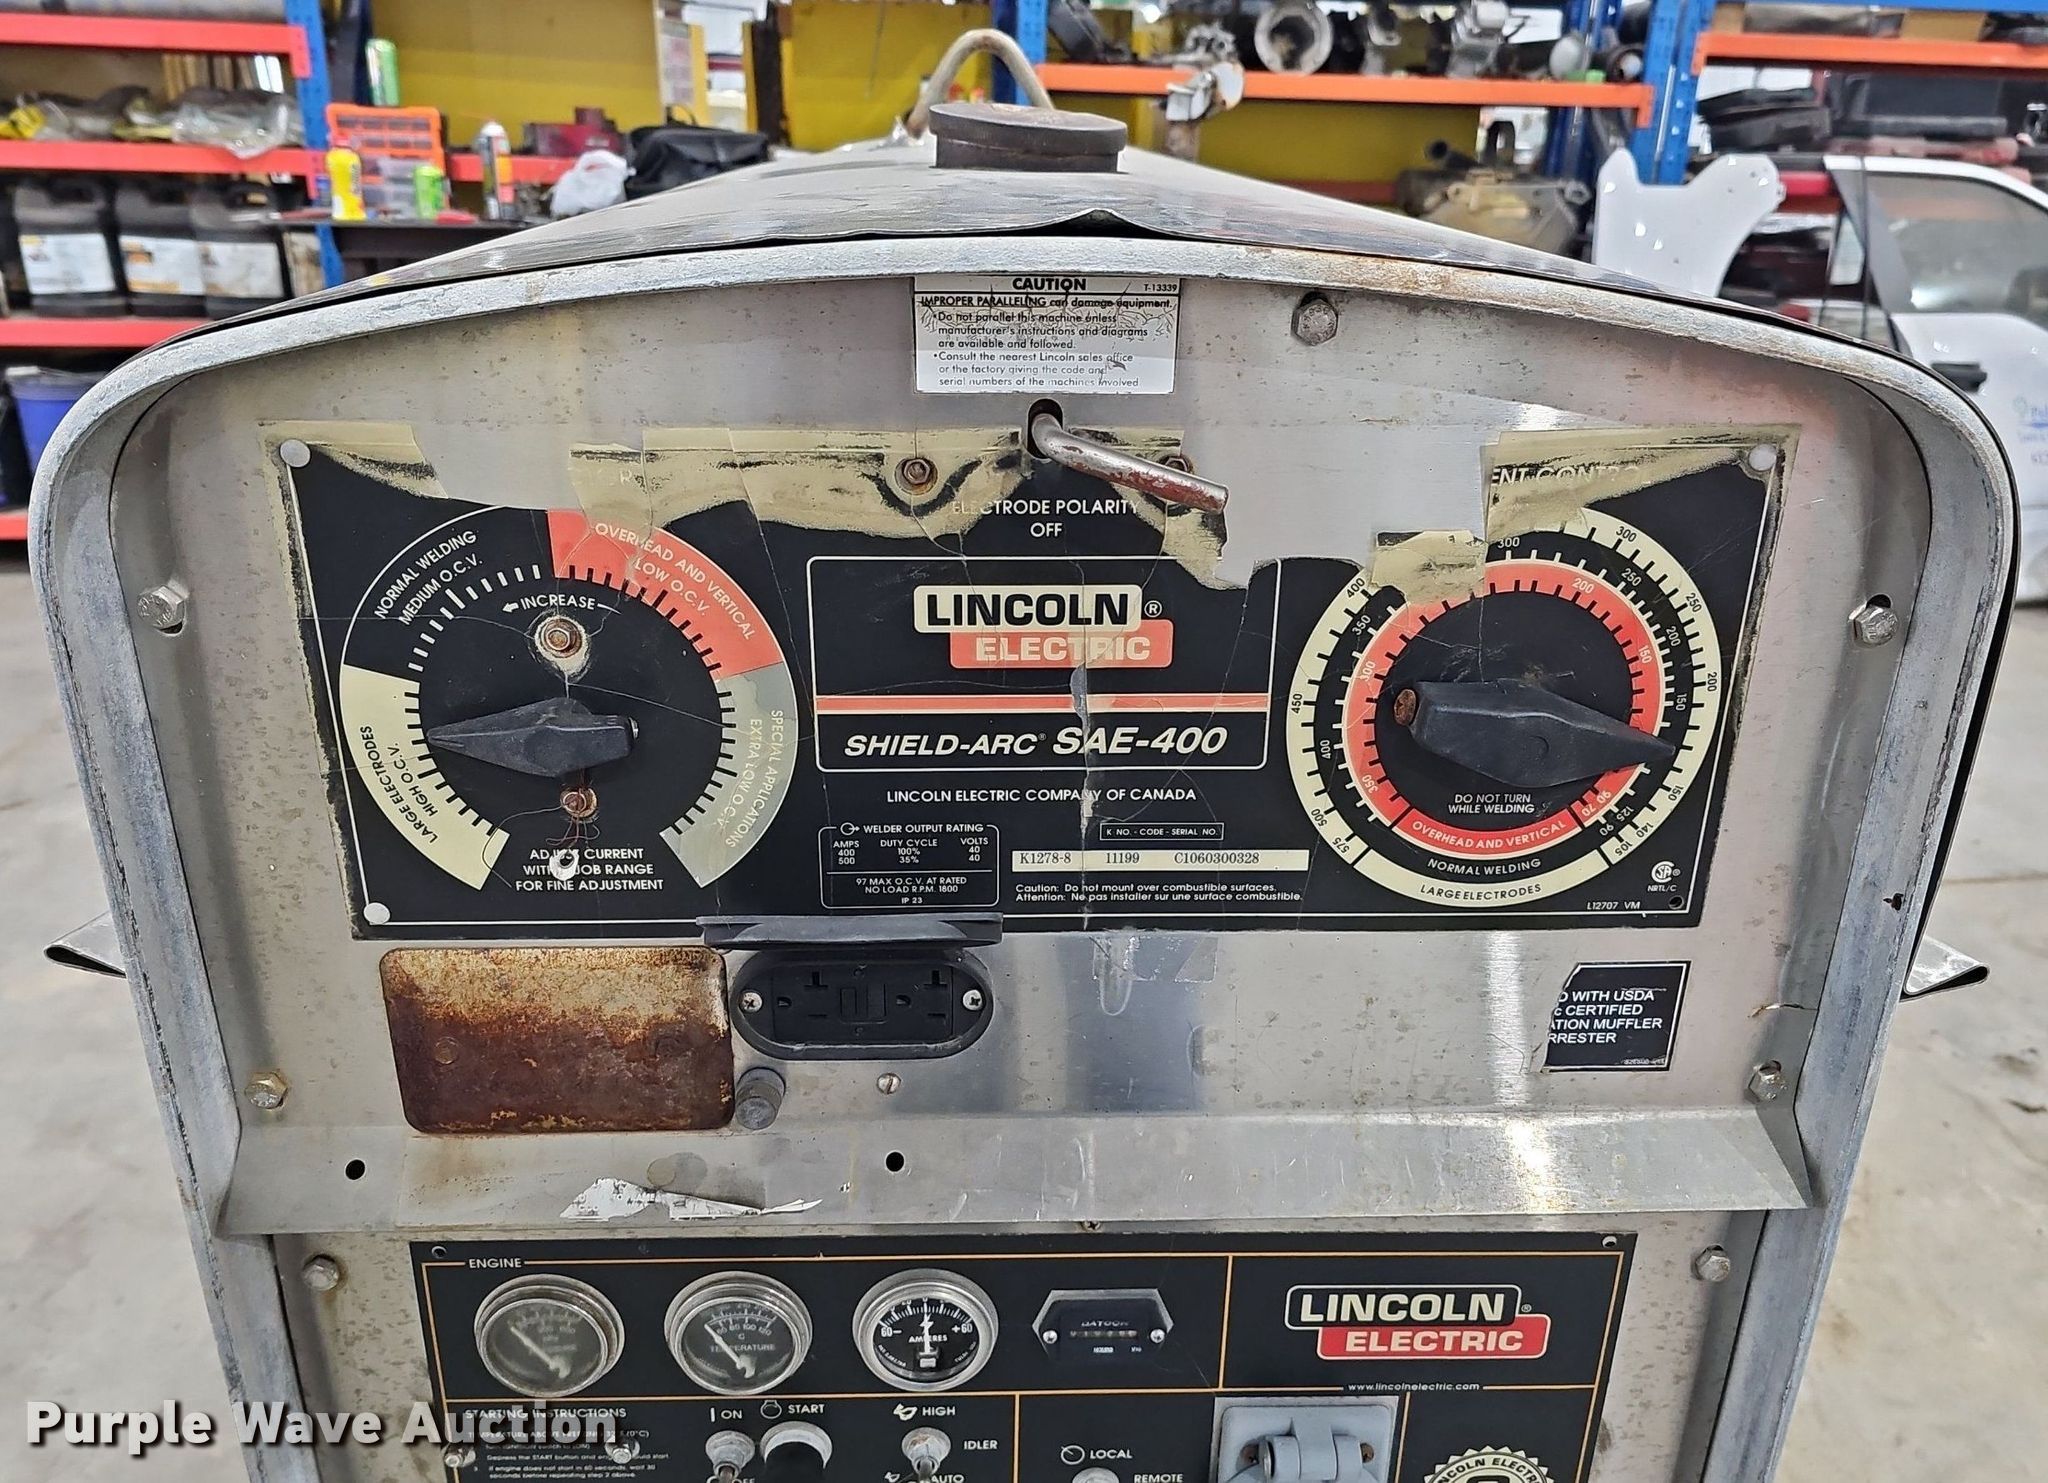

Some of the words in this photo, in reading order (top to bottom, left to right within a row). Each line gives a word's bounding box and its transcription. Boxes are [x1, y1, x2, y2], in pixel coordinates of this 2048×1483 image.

[1012, 277, 1086, 291] CAUTION
[1144, 283, 1177, 292] T-13339
[921, 296, 974, 306] IMPROPER
[977, 296, 1046, 307] PARALLELING
[1050, 299, 1068, 307] can
[1117, 298, 1172, 309] equipment.
[938, 311, 952, 321] Do
[956, 312, 972, 321] not
[976, 311, 1014, 323] parallel
[1018, 312, 1035, 321] this
[1039, 312, 1081, 322] machine
[1085, 312, 1117, 322] unless
[938, 325, 1015, 335] manufacturer's
[1018, 326, 1075, 336] instructions
[1079, 326, 1098, 336] and
[1101, 326, 1148, 338] diagrams
[938, 340, 955, 348] are
[958, 338, 1004, 348] available
[1007, 338, 1027, 349] and
[1030, 339, 1076, 349] followed.
[938, 351, 976, 361] Consult
[979, 351, 995, 361] the
[999, 352, 1036, 361] nearest
[1040, 352, 1075, 361] Lincoln
[1078, 352, 1102, 362] sales
[1107, 352, 1133, 362] office
[1055, 499, 1138, 515] POLARITY
[1029, 522, 1063, 538] OFF
[1615, 525, 1637, 543] 300
[1497, 536, 1520, 549] 300
[374, 567, 420, 619] NORMAL
[415, 530, 477, 569] WELDING
[595, 523, 674, 562] OVERHEAD
[675, 558, 706, 584] AND
[707, 580, 756, 640] VERTICAL
[1621, 567, 1642, 587] 250
[398, 578, 442, 625] MEDIUM
[439, 553, 483, 582] O.C.V.
[634, 557, 667, 582] LOW
[670, 580, 711, 616] O.C.V.
[1346, 577, 1366, 598] 400
[1571, 577, 1595, 594] 200
[520, 594, 596, 610] INCREASE
[926, 592, 1129, 626] LINCOLN
[1685, 592, 1702, 613] 250
[1352, 614, 1371, 636] 350
[1665, 625, 1681, 647] 200
[975, 636, 1151, 662] ELECTRIC
[1638, 645, 1653, 664] 150
[1706, 671, 1718, 692] 200
[1291, 693, 1303, 714] 450
[1675, 693, 1687, 711] 150
[1052, 727, 1228, 755] SAE-400
[1320, 739, 1331, 759] 400
[360, 725, 404, 805] ELECTRODES
[387, 743, 414, 783] O.C.V.
[887, 790, 951, 803] LINCOLN
[955, 789, 1021, 802] ELECTRIC
[1025, 789, 1101, 801] COMPANY
[1106, 789, 1127, 801] OF
[1130, 788, 1197, 801] CANADA
[1454, 794, 1473, 803] DO
[1476, 794, 1500, 803] NOT
[1504, 794, 1531, 803] TURN
[1668, 785, 1684, 801] 150
[408, 785, 439, 817] HIGH
[1448, 804, 1481, 814] WHILE
[1484, 803, 1535, 813] WELDING
[398, 804, 439, 843] LARGE
[1311, 808, 1328, 827] 500
[863, 825, 902, 834] WELDER
[905, 824, 944, 833] OUTPUT
[946, 823, 984, 833] RATING
[1412, 820, 1474, 848] OVERHEAD
[1476, 838, 1503, 849] AND
[1505, 820, 1567, 847] VERTICAL
[1636, 822, 1654, 838] 140
[833, 840, 859, 849] AMPS
[880, 839, 903, 847] DUTY
[906, 838, 938, 847] CYCLE
[960, 837, 989, 845] VOLTS
[1332, 837, 1350, 854] 575
[1615, 840, 1633, 856] 105
[584, 848, 644, 860] CURRENT
[838, 849, 855, 857] 400
[897, 847, 920, 856] 100%
[968, 846, 981, 854] 40
[1020, 852, 1071, 864] K1278-8
[1106, 852, 1140, 864] 11199
[1174, 852, 1260, 864] C1060300328
[838, 857, 855, 865] 500
[899, 856, 919, 864] 35%
[968, 854, 981, 862] 40
[1427, 858, 1481, 875] NORMAL
[1484, 858, 1541, 875] WELDING
[576, 864, 601, 876] JOB
[605, 864, 654, 875] RANGE
[515, 880, 543, 891] FOR
[547, 880, 574, 891] FINE
[578, 879, 664, 890] ADJUSTMENT
[856, 878, 867, 886] 97
[869, 877, 892, 886] MAX
[895, 877, 924, 885] O.C.V.
[926, 876, 937, 885] AT
[939, 876, 967, 885] RATED
[1015, 884, 1059, 892] Caution:
[1064, 884, 1078, 892] Do
[1082, 884, 1098, 892] not
[1101, 884, 1134, 892] mount
[1162, 883, 1227, 892] combustible
[1230, 884, 1276, 892] surfaces.
[865, 886, 880, 894] NO
[882, 885, 909, 894] LOAD
[911, 885, 936, 893] R.P.M.
[939, 884, 959, 893] 1800
[1420, 884, 1460, 899] LARGE
[1463, 883, 1541, 901] ELECTRODES
[1015, 893, 1066, 901] Attention:
[1071, 893, 1085, 901] Ne
[1088, 894, 1107, 903] pas
[1110, 892, 1152, 901] installer
[1154, 893, 1169, 901] sur
[1172, 893, 1191, 901] une
[1193, 892, 1233, 901] surface
[1235, 892, 1303, 901] combustible.
[1587, 901, 1619, 910] L12707
[1624, 901, 1641, 910] VM
[1572, 990, 1610, 1002] WITH
[1613, 990, 1655, 1001] USDA
[1565, 1004, 1643, 1016] CERTIFIED
[1593, 1018, 1662, 1029] MUFFLER
[1549, 1033, 1617, 1044] RRESTER
[468, 1257, 522, 1269] ENGINE
[1300, 1293, 1505, 1322] LINCOLN
[1345, 1330, 1524, 1352] ELECTRIC
[1348, 1382, 1480, 1392] www.lincolnelectric.com
[465, 1408, 528, 1419] STARTING
[533, 1407, 627, 1419] INSTRUCTIONS
[720, 1409, 742, 1420] ON
[788, 1403, 825, 1415] START
[922, 1405, 955, 1417] HIGH
[963, 1439, 998, 1450] IDLER
[1089, 1449, 1133, 1459] LOCAL
